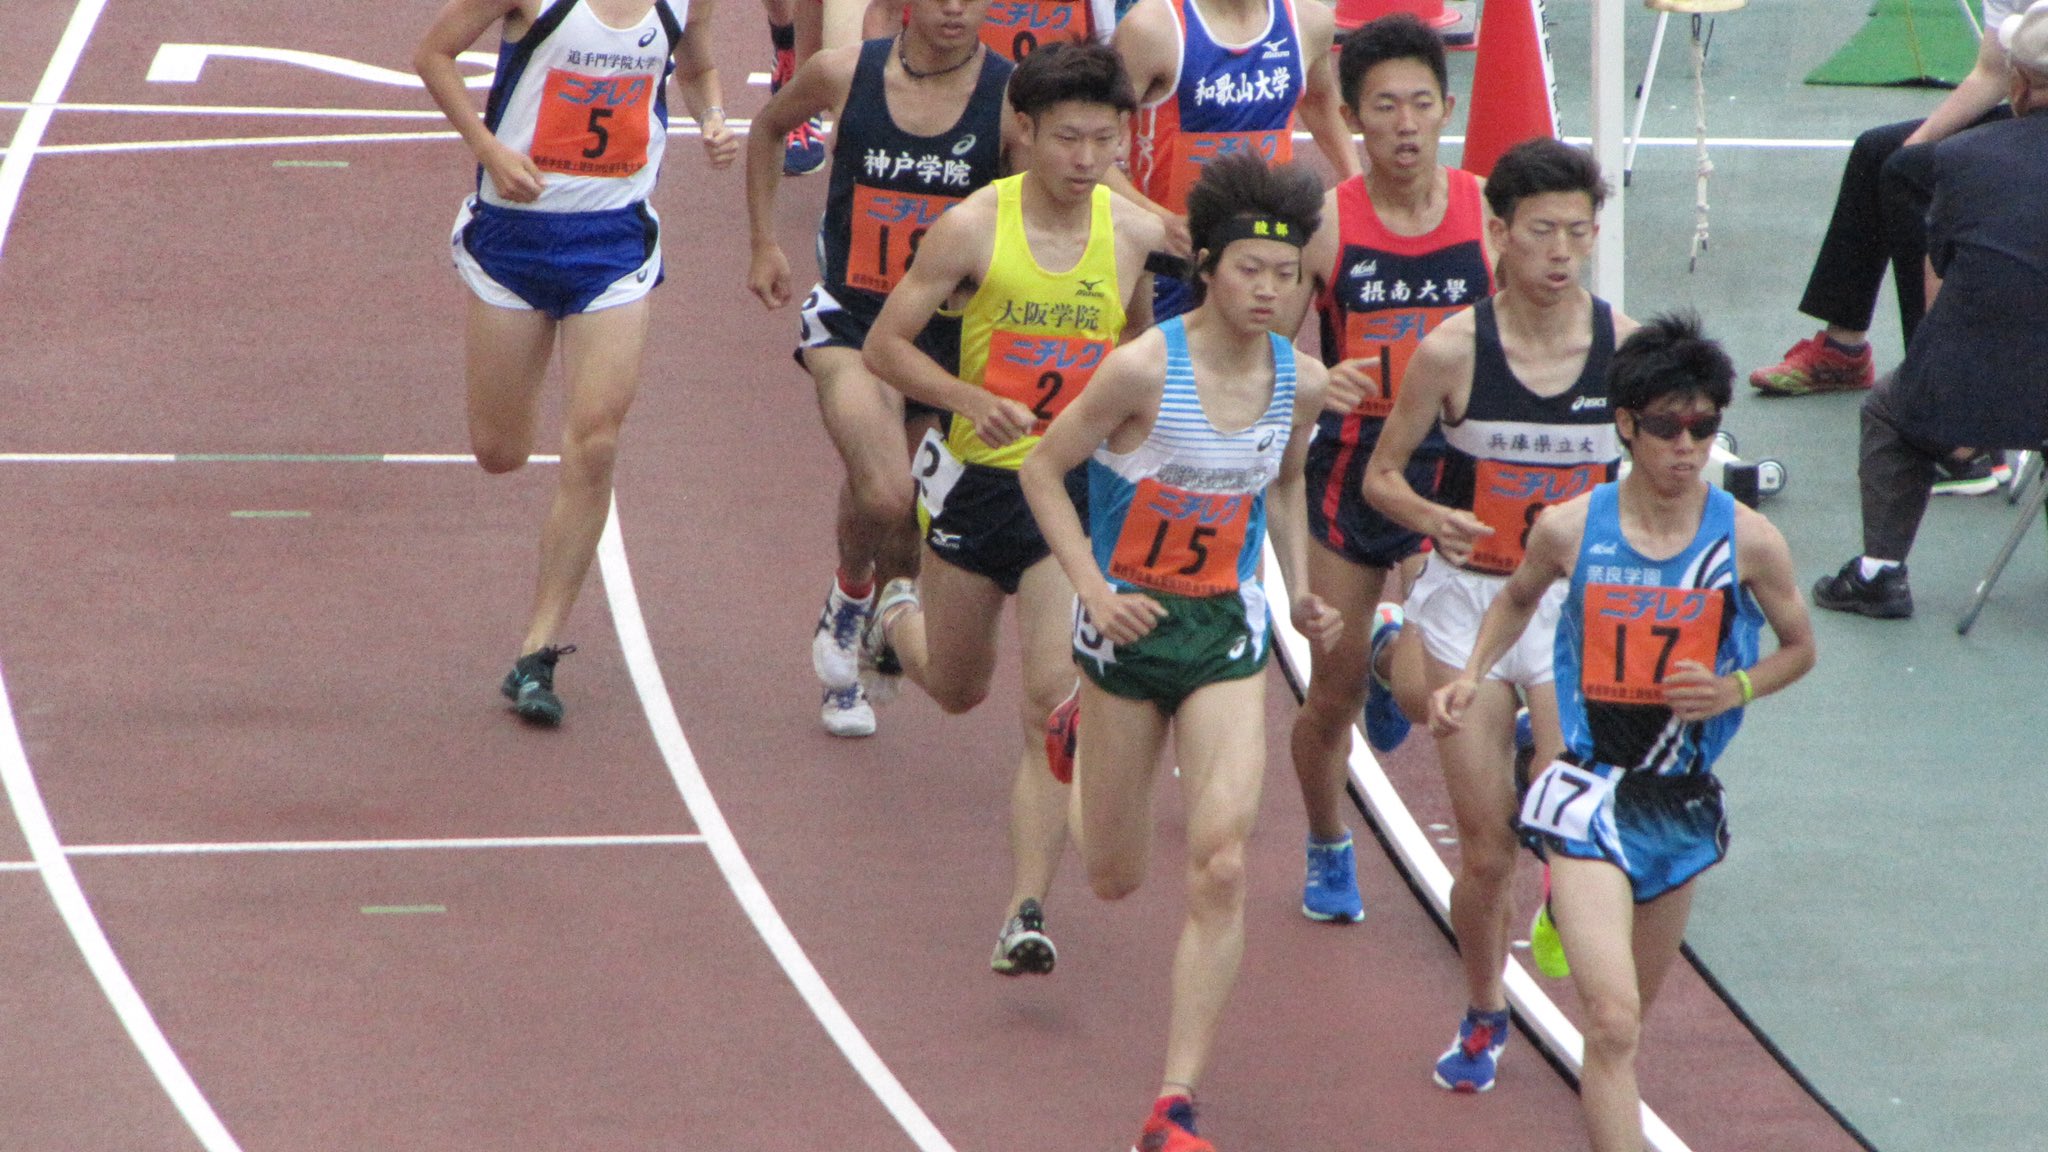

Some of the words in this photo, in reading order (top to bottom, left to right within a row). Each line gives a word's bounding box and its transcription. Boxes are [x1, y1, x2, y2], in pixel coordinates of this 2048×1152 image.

[567, 49, 657, 70] 追手門学院大学
[558, 77, 646, 106] ニチレク
[1195, 66, 1290, 106] 和歌山大学
[582, 107, 613, 159] 5
[864, 149, 971, 186] 神戸学院
[867, 197, 961, 225] ニチレ
[1360, 278, 1467, 303] 摂南大學
[996, 299, 1100, 330] 大阪学院
[1003, 339, 1105, 369] ニチレク
[1032, 370, 1063, 420] 2
[1487, 433, 1594, 453] 兵庫県立大
[1491, 469, 1590, 500] ニチレク
[1147, 490, 1242, 525] ニチレク
[1143, 519, 1217, 576] 15
[1600, 590, 1707, 621] ニチレク
[1615, 623, 1681, 684] 17
[1533, 767, 1592, 827] 17
